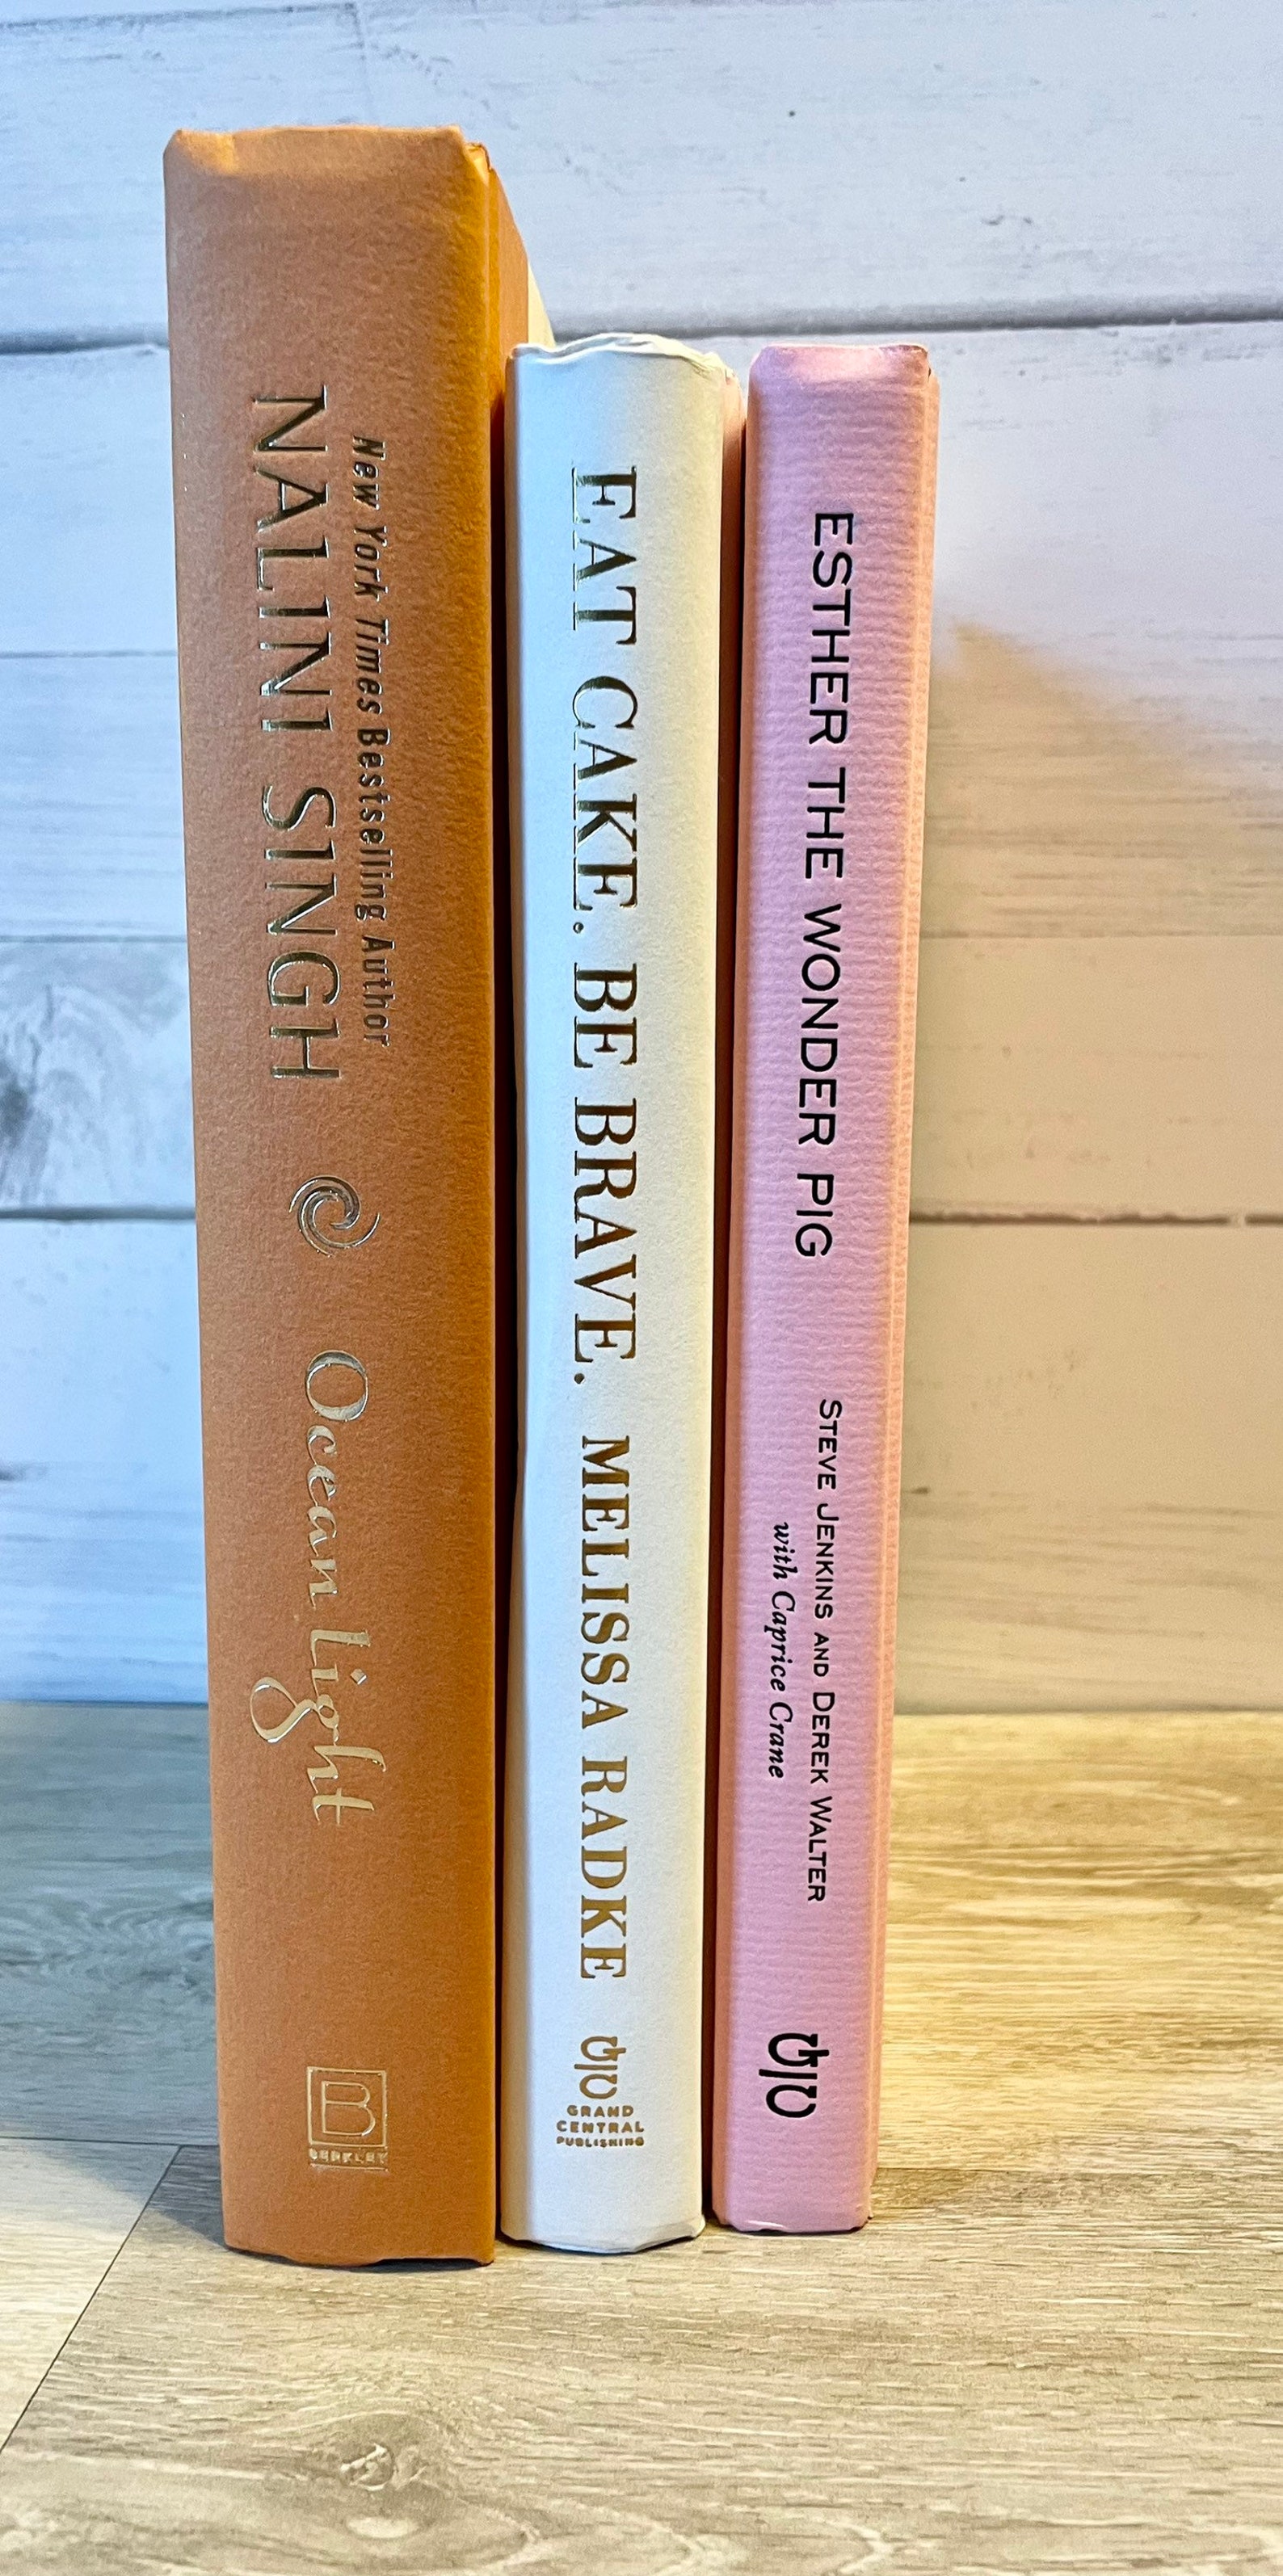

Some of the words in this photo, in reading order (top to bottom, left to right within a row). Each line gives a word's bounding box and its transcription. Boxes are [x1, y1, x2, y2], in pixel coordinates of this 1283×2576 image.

[353, 435, 385, 510] New
[251, 385, 334, 732] NALINI
[354, 526, 389, 601] York
[571, 464, 637, 645] EAT
[355, 619, 389, 715] Times
[807, 512, 854, 745] ESTHER
[355, 729, 393, 920] Bestselling
[572, 675, 638, 934] CAKE.
[805, 767, 847, 880] THE
[261, 786, 343, 1080] SINGH
[362, 935, 396, 1047] Author
[574, 962, 637, 1068] BE
[798, 903, 842, 1146] WONDER
[574, 1097, 637, 1384] BRAVE.
[796, 1173, 834, 1258] PIG
[305, 1350, 368, 1611] Ocean
[580, 1435, 630, 1729] MELISSA
[773, 1522, 798, 1580] with
[764, 1591, 796, 1691] Caprice
[768, 1701, 793, 1779] Crane
[580, 1755, 628, 1979] RADKE
[309, 2148, 388, 2164] BERKLEY
[322, 2081, 375, 2137] B
[557, 2120, 645, 2133] CENTRAL
[557, 2136, 645, 2147] PUBLISHING
[567, 2105, 634, 2117] GRAND
